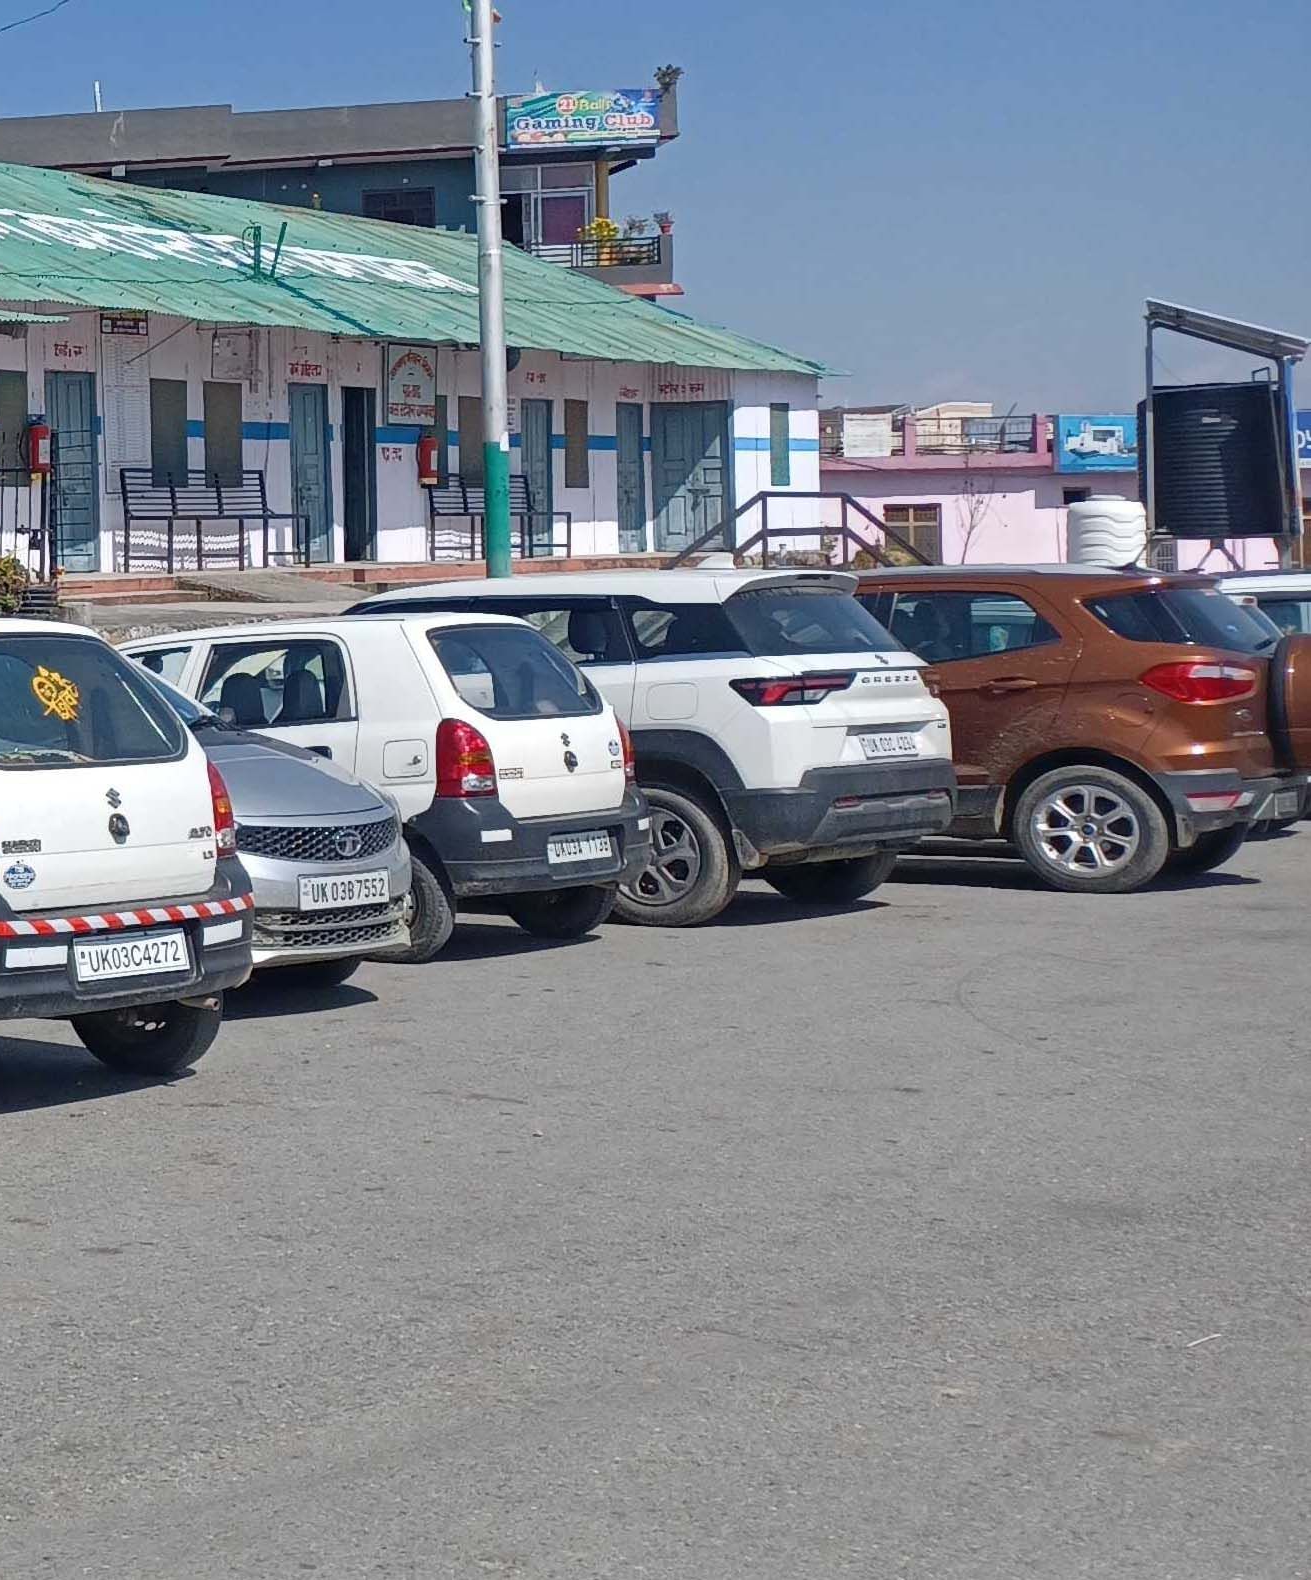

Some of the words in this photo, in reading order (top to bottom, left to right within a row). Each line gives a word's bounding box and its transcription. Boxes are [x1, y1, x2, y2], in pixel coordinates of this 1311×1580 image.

[516, 116, 597, 130] Gaming
[604, 112, 653, 127] Club
[311, 882, 329, 903] UK
[88, 940, 181, 972] UK03C4272
